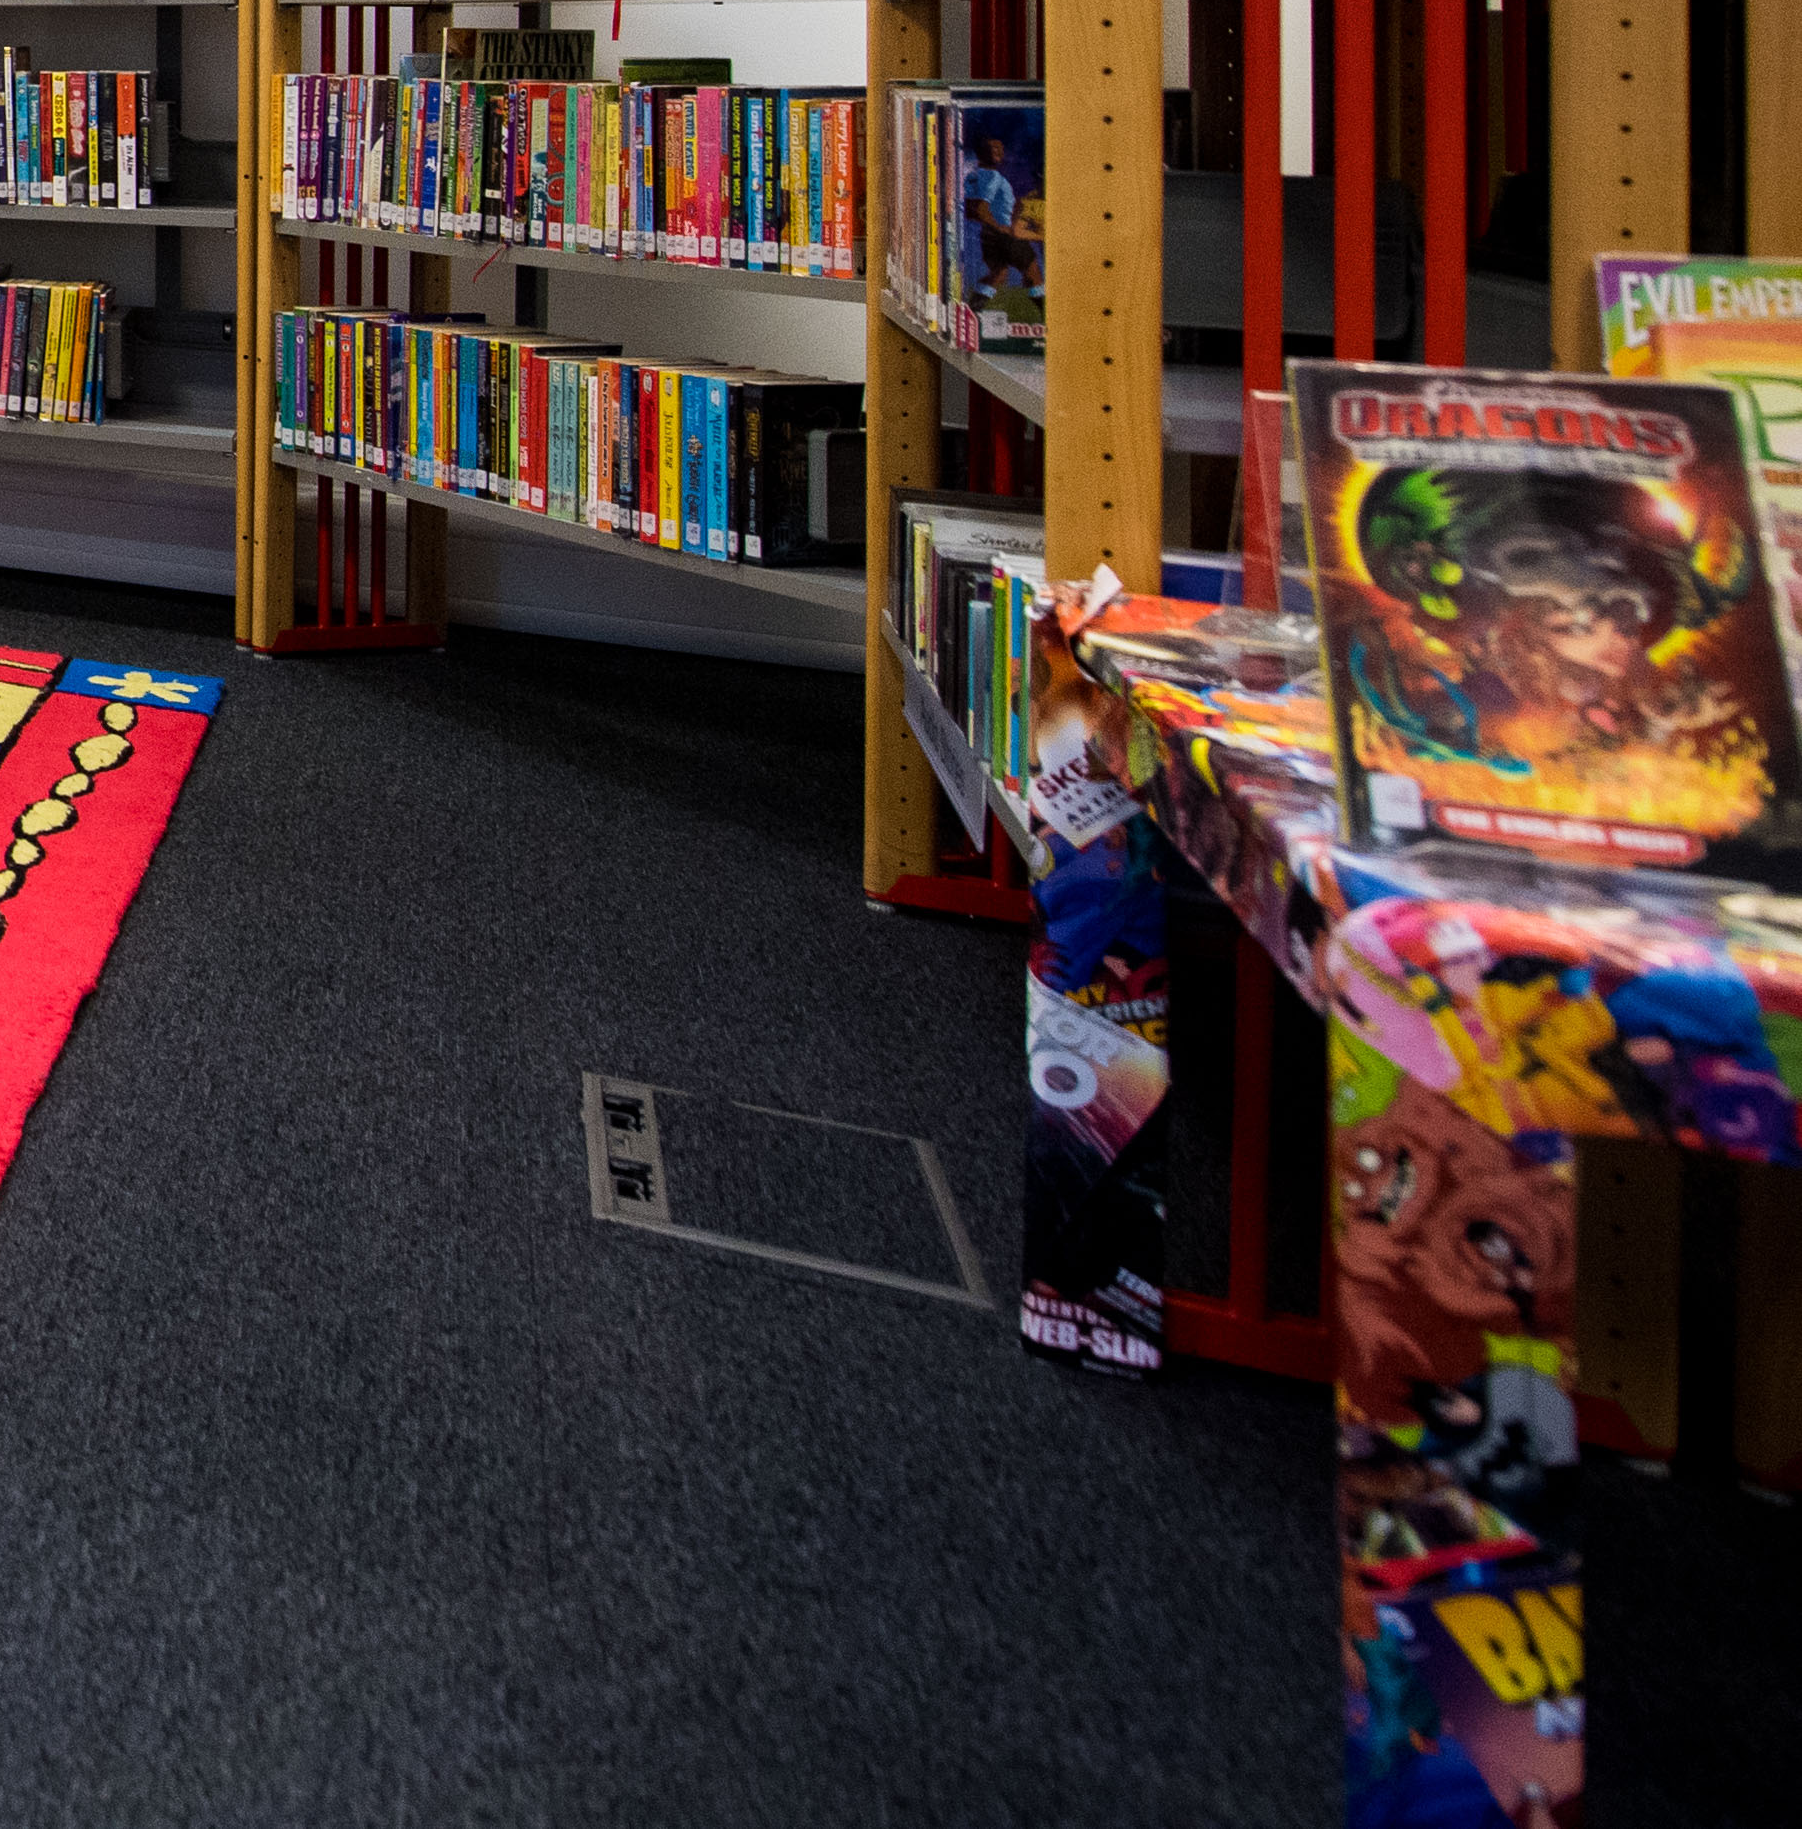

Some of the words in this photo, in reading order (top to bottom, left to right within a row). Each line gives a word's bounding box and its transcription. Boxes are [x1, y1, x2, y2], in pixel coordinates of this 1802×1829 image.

[482, 32, 518, 63] THE
[522, 32, 595, 63] STINKY
[1618, 272, 1708, 347] EVIL
[1338, 394, 1686, 456] DRAGONS
